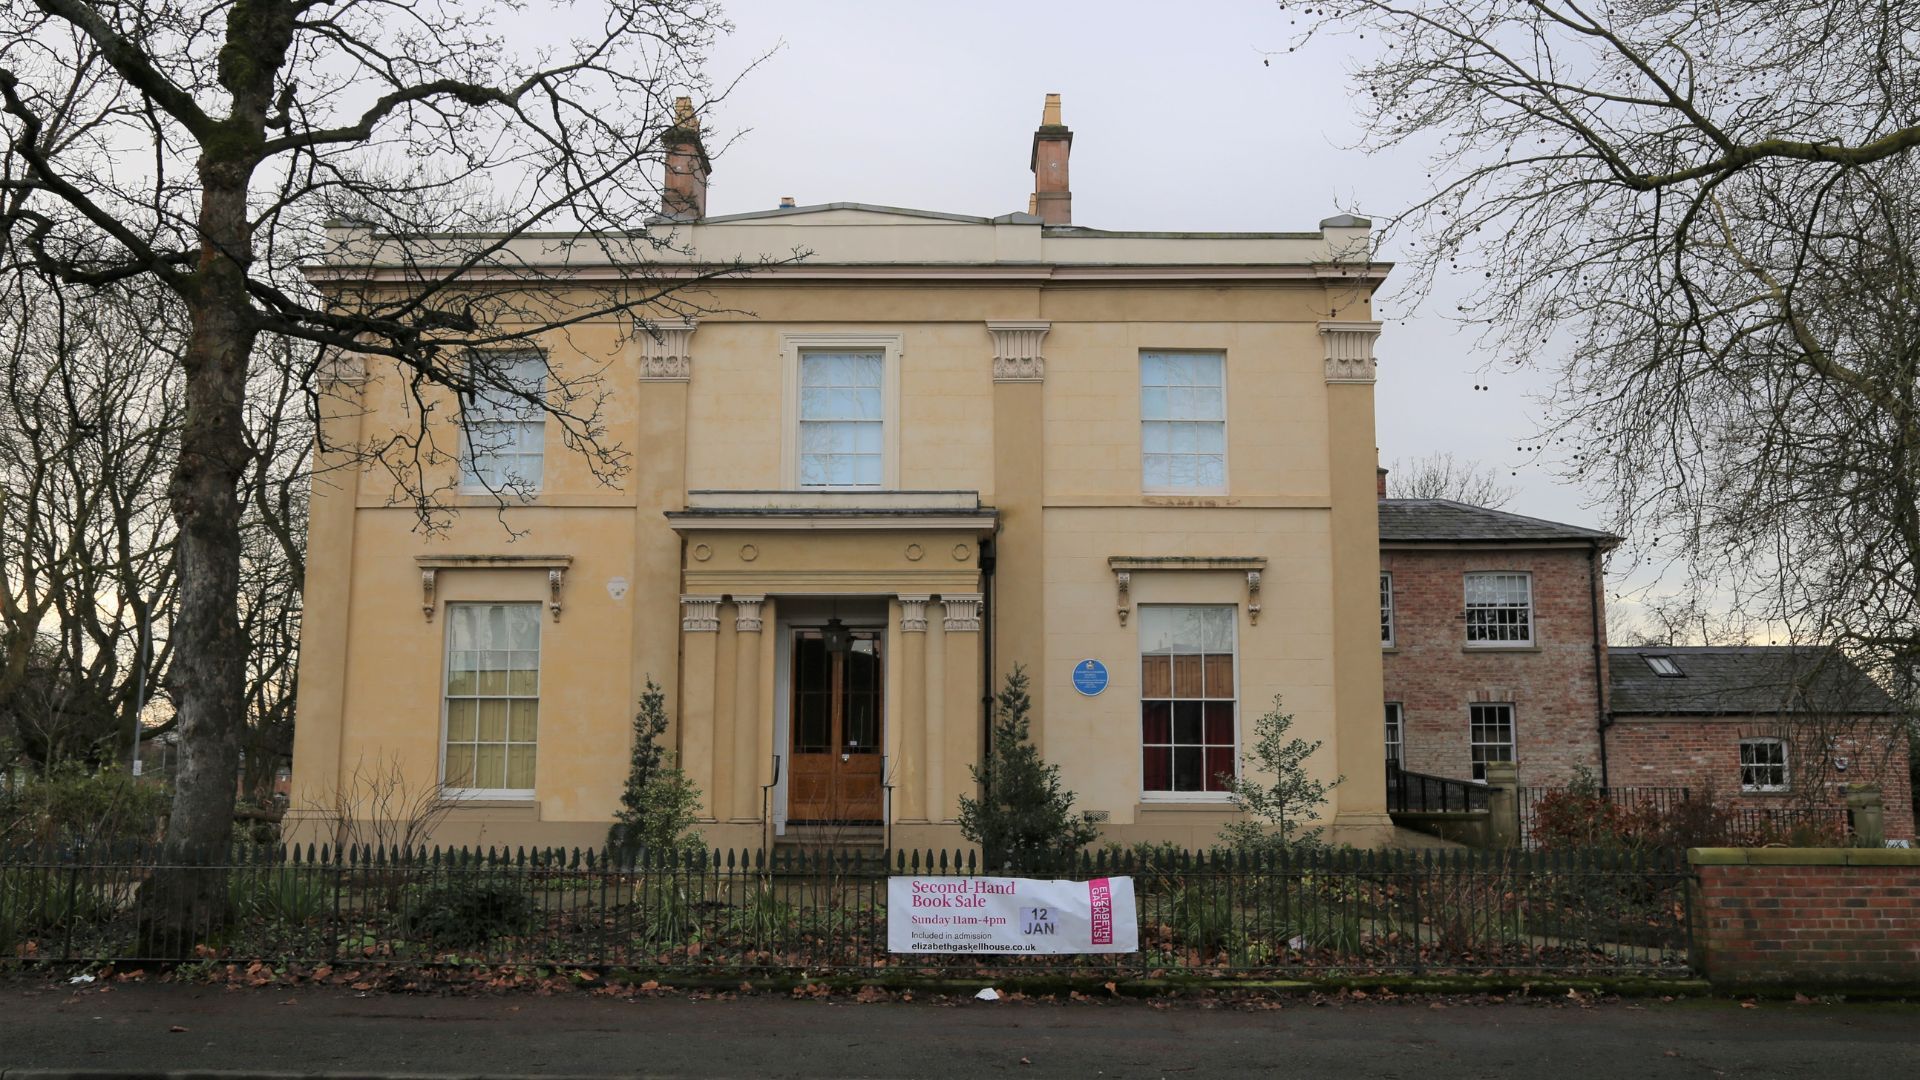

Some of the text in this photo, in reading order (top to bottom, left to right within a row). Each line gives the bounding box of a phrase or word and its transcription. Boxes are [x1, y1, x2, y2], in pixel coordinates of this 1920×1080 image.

[912, 880, 1015, 895] Second-Hand
[912, 894, 986, 908] Book Sale
[1031, 908, 1048, 921] 12
[1092, 887, 1102, 938] GASKELL'S
[1100, 886, 1111, 938] ELIZABETH
[911, 915, 1006, 927] Sunday 11am-4pm
[1024, 922, 1054, 935] JAN
[911, 931, 992, 940] Included in admission
[911, 942, 1036, 952] elizabethgaskellhouse.co.uk
